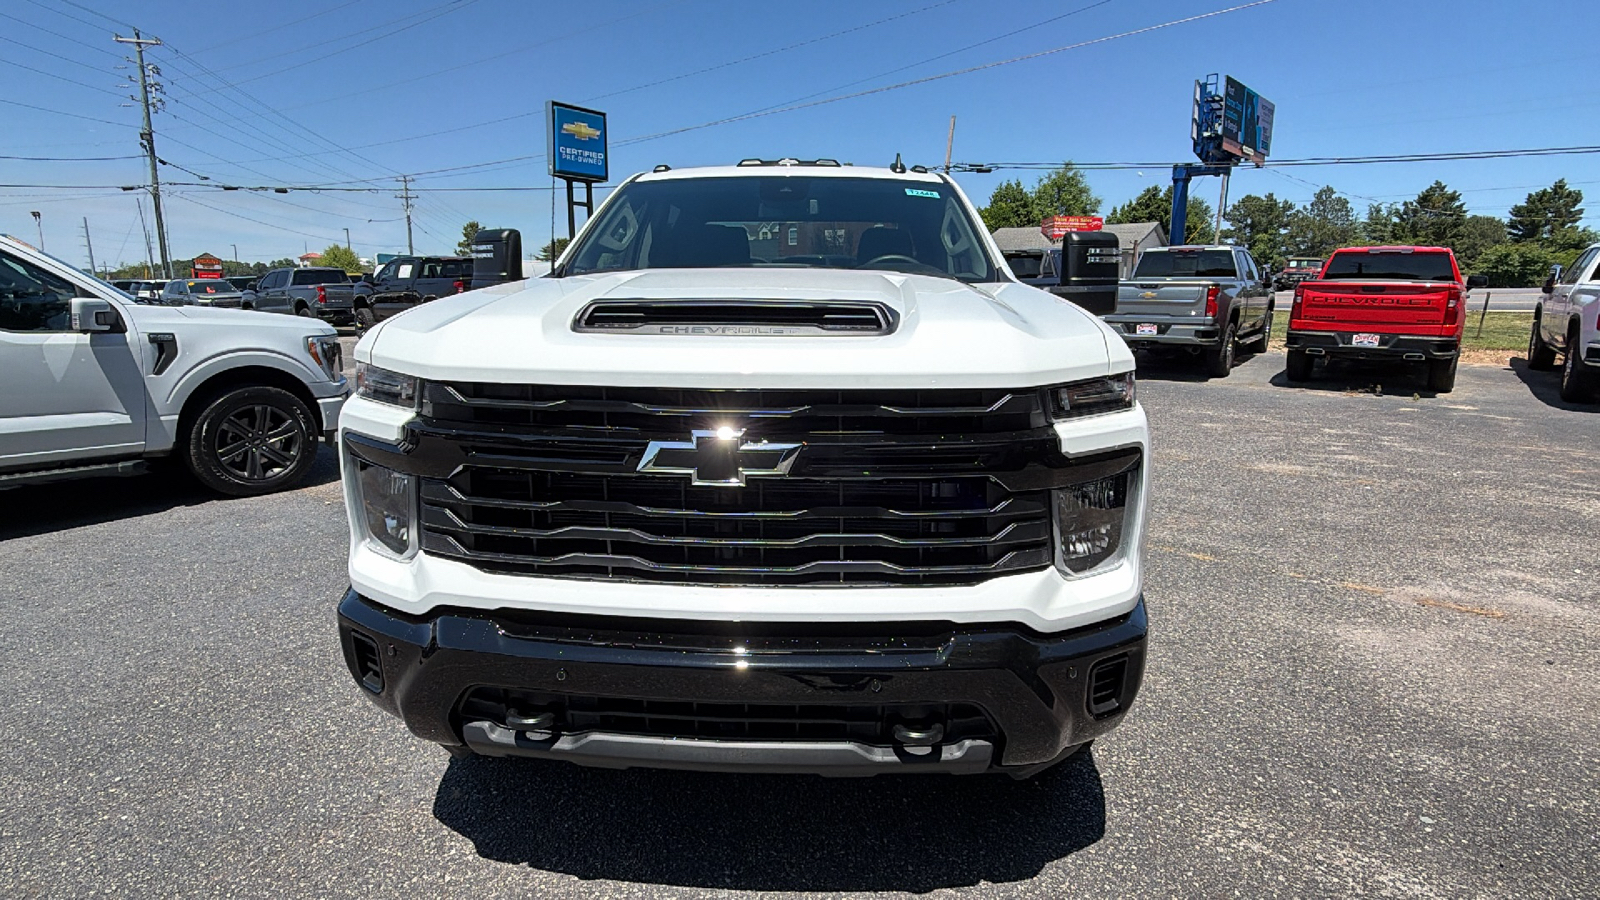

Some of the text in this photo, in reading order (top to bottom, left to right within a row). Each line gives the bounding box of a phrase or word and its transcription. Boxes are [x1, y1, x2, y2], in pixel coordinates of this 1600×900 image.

[559, 146, 604, 159] CERTIFIED
[562, 153, 602, 165] PRE-OWNED
[1312, 296, 1432, 306] CHEVROLET
[659, 325, 801, 334] CHEVROLET
